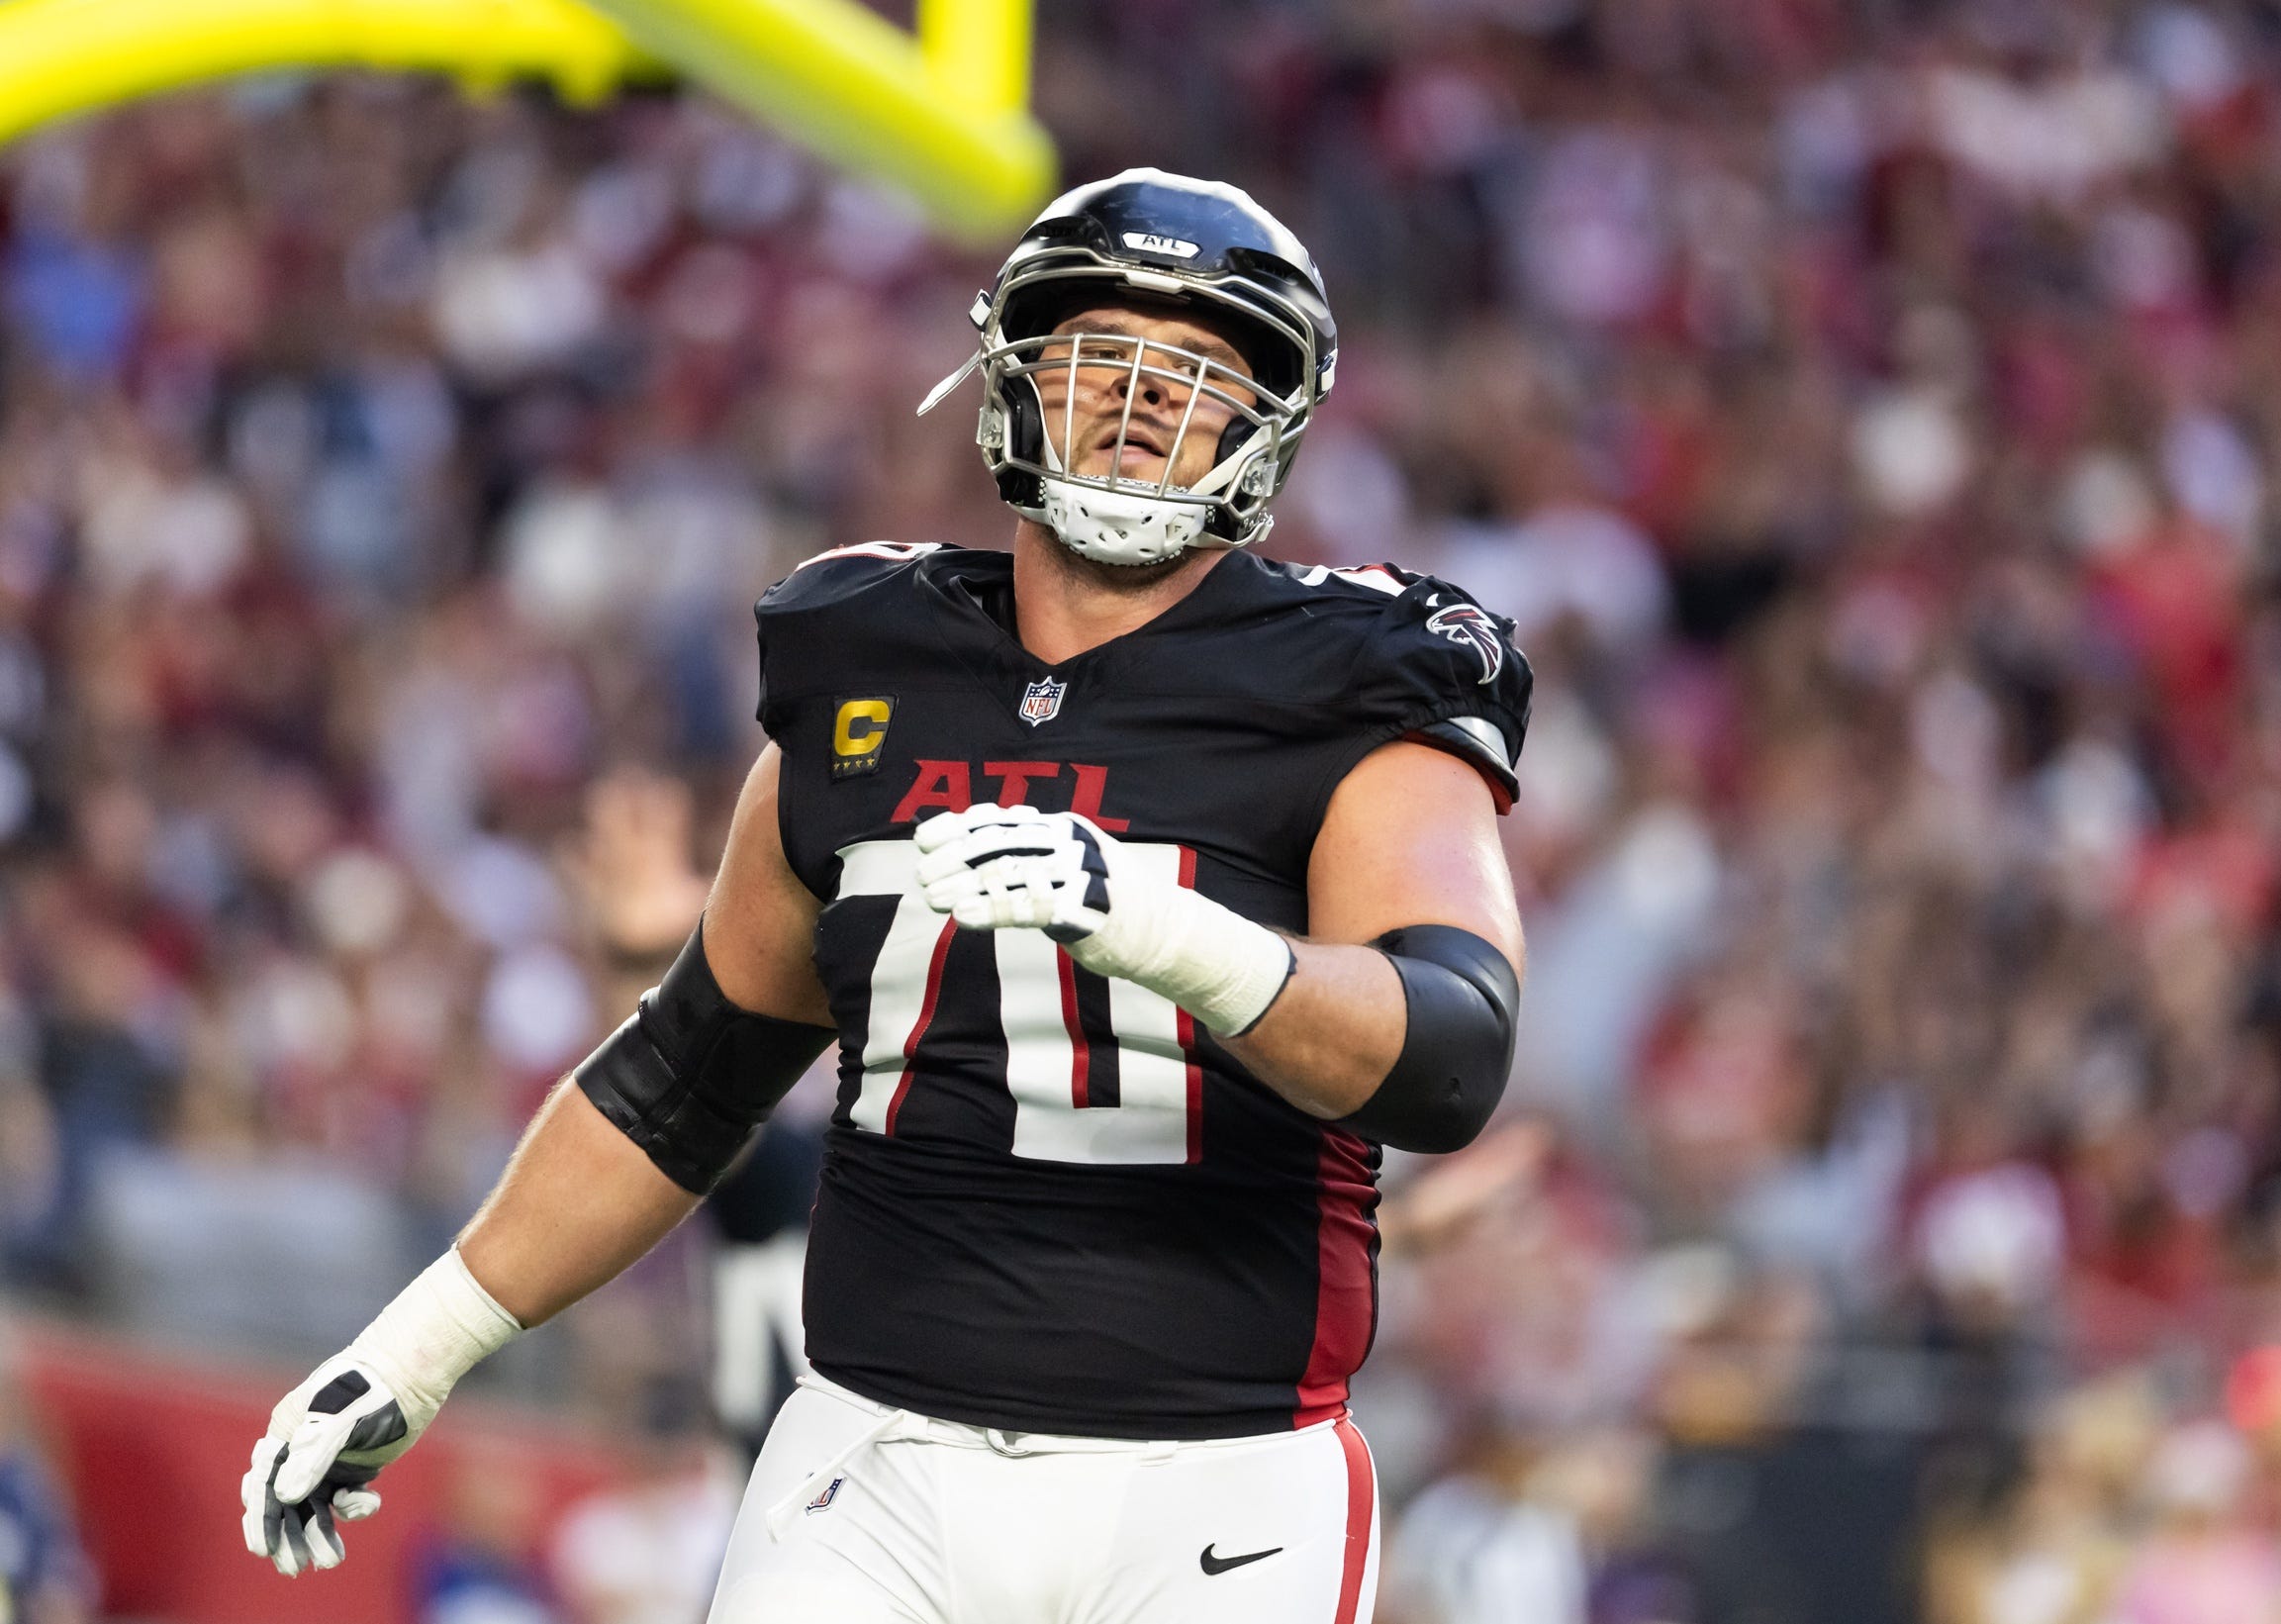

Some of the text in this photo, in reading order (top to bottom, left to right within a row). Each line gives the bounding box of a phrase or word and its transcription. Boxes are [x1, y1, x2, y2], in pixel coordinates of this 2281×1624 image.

[1142, 235, 1181, 250] ATL
[834, 700, 891, 757] C
[1025, 698, 1054, 716] NFL
[891, 759, 1130, 832] ATL
[834, 839, 1203, 1165] 70
